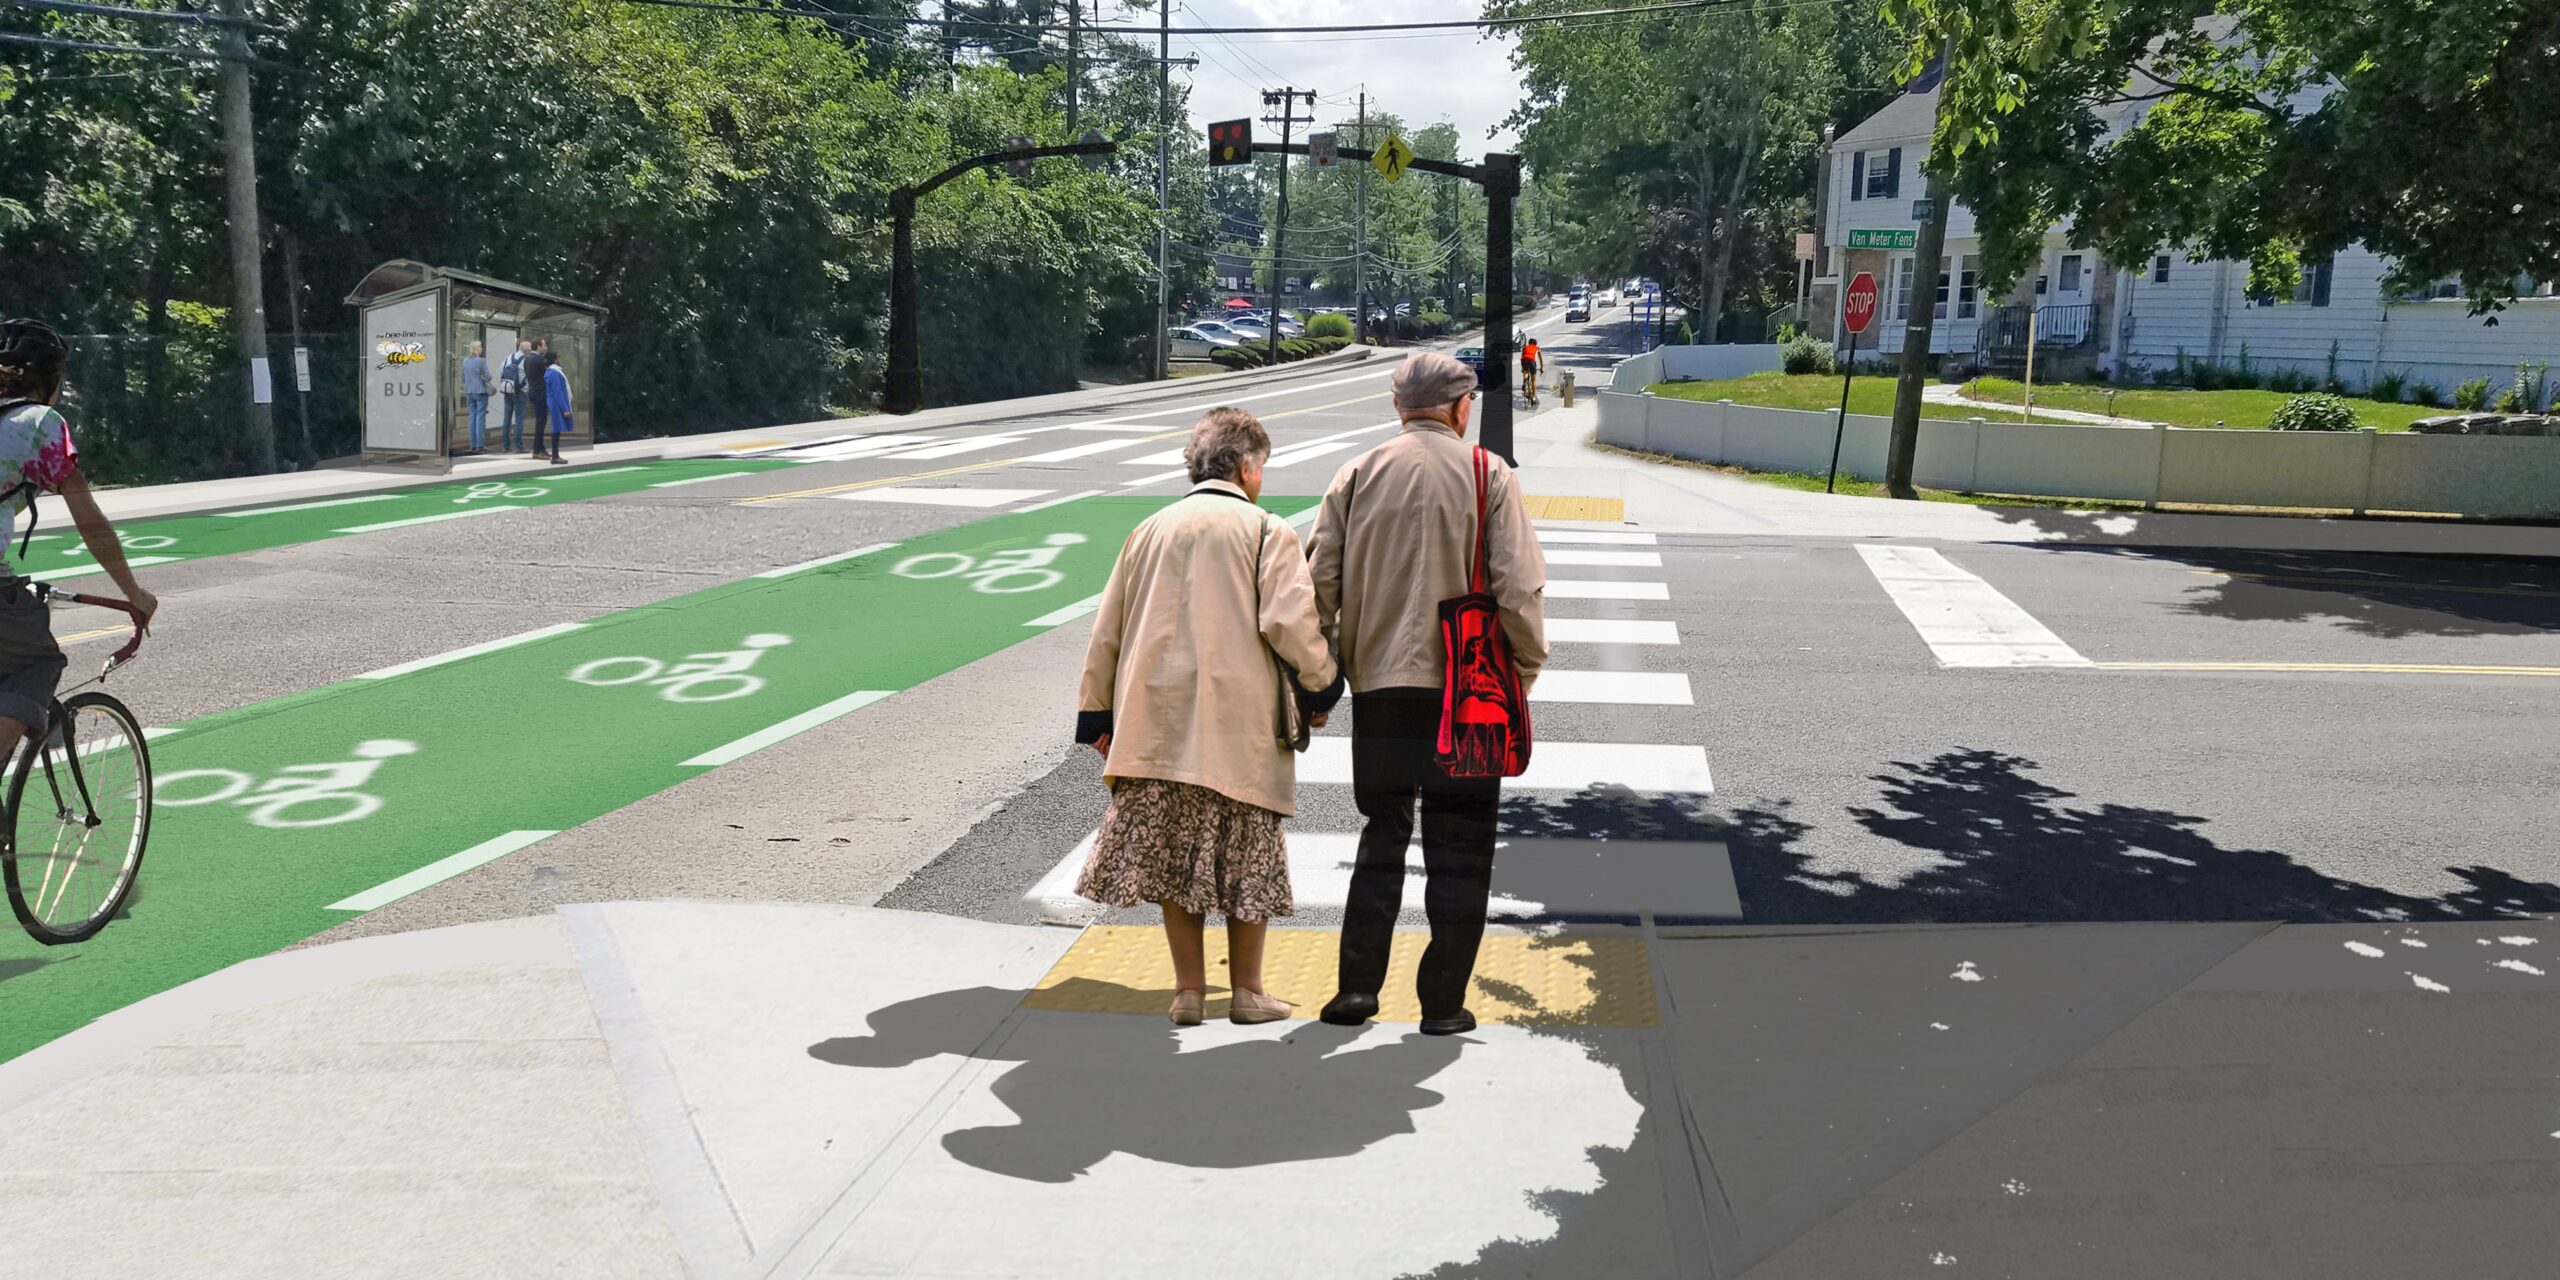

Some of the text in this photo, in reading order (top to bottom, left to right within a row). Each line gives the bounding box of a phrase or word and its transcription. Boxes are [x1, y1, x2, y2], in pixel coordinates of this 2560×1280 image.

[1851, 231, 1913, 246] Van Meter Fens
[1847, 292, 1875, 314] STOP
[384, 382, 425, 397] BUS
